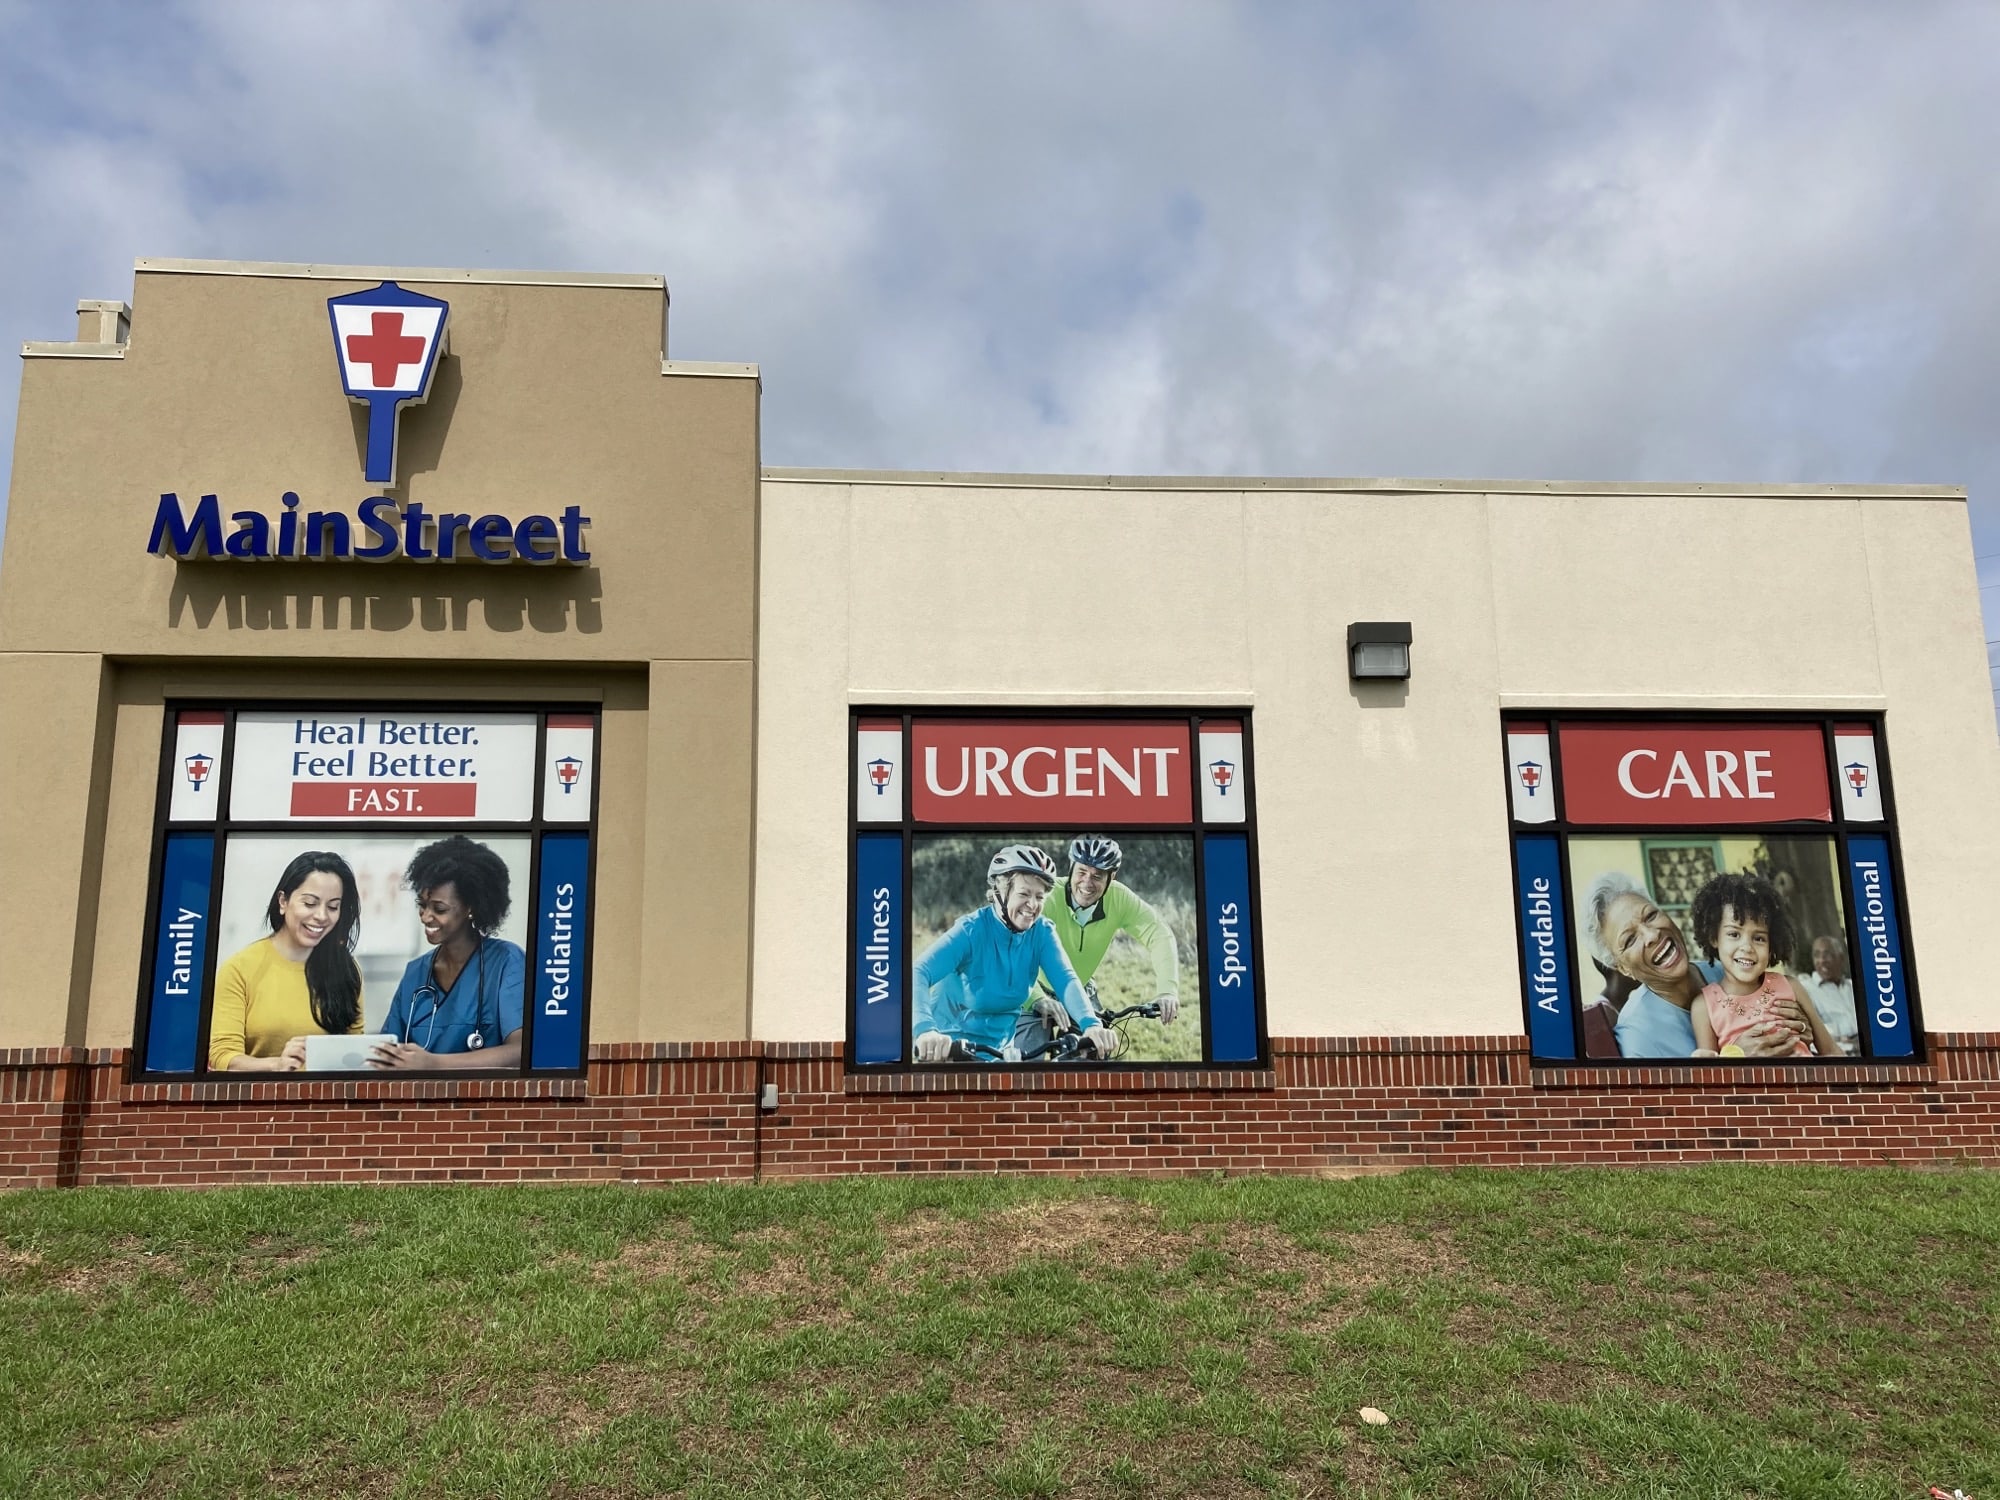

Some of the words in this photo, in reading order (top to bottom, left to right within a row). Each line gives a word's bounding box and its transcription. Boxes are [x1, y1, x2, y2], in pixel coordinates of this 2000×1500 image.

[147, 491, 591, 562] MainStreet
[292, 749, 354, 777] Feel
[368, 751, 477, 778] Better.
[293, 717, 366, 745] Heal
[379, 719, 479, 746] Better.
[347, 788, 424, 812] FAST.
[924, 746, 1180, 798] URGENT
[1617, 749, 1776, 800] CARE
[165, 907, 202, 996] Family
[545, 882, 574, 1017] Pediatrics
[866, 887, 890, 1005] Wellness
[1219, 902, 1247, 988] Sports
[1528, 876, 1560, 1014] Affordable
[1855, 860, 1898, 1029] Occupational
